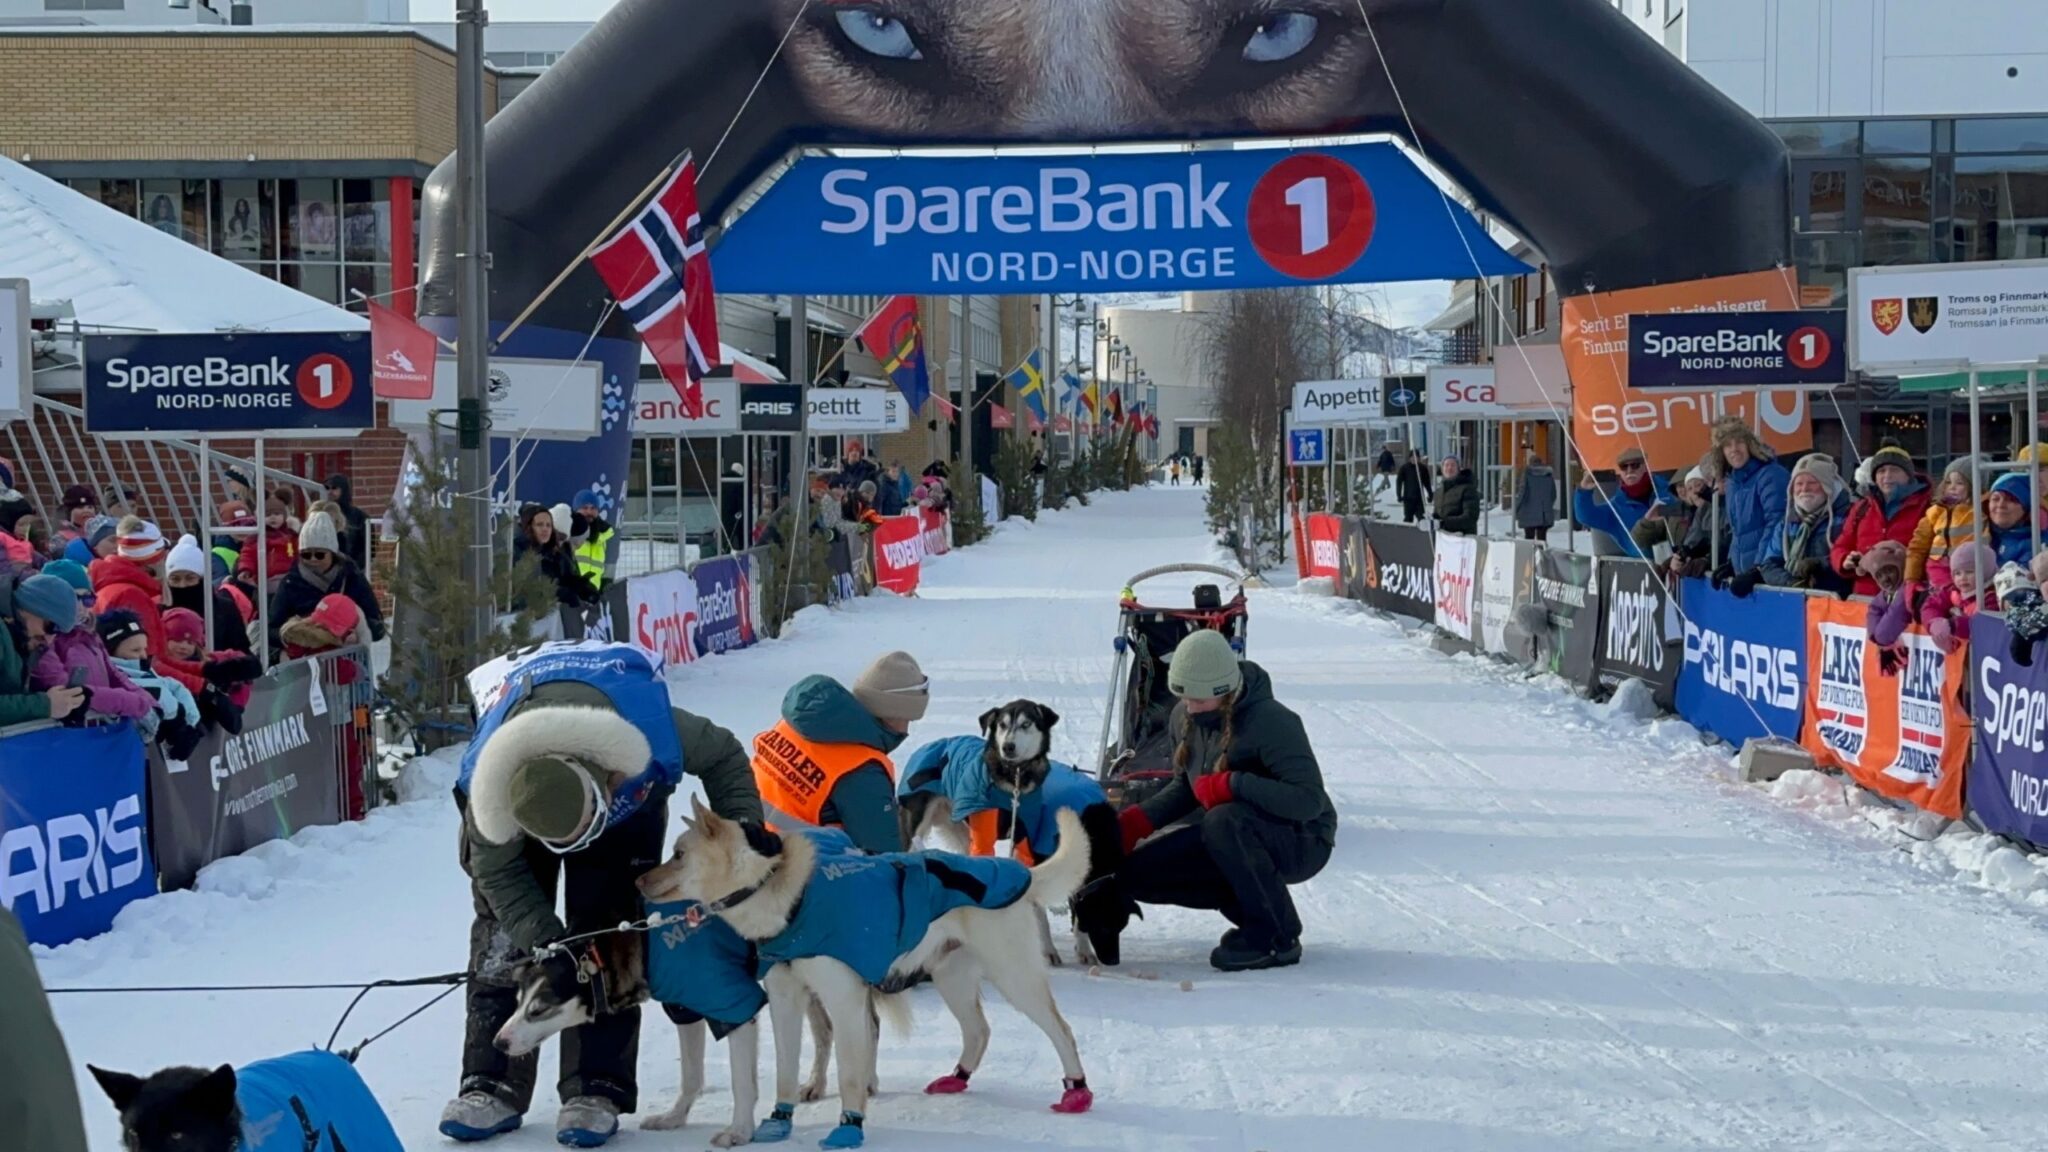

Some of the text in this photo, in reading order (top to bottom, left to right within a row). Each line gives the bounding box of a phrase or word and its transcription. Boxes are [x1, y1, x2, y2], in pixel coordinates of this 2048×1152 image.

[820, 163, 1233, 247] SpareBank
[930, 246, 1237, 284] NORD-NORGE
[1948, 295, 1981, 304] Troms
[1983, 294, 1997, 304] og
[1643, 328, 1783, 357] SpareBank
[105, 356, 291, 393] SpareBank
[1680, 356, 1784, 370] NORD-NORGE
[156, 393, 292, 409] NORD-NORGE
[634, 397, 721, 421] andic
[741, 401, 794, 415] ARIS
[699, 577, 738, 635] pareBank
[1683, 619, 1801, 711] POLARIS
[1822, 633, 1863, 688] LAKS
[1981, 655, 2048, 754] Spare
[244, 711, 311, 767] FINNMARK
